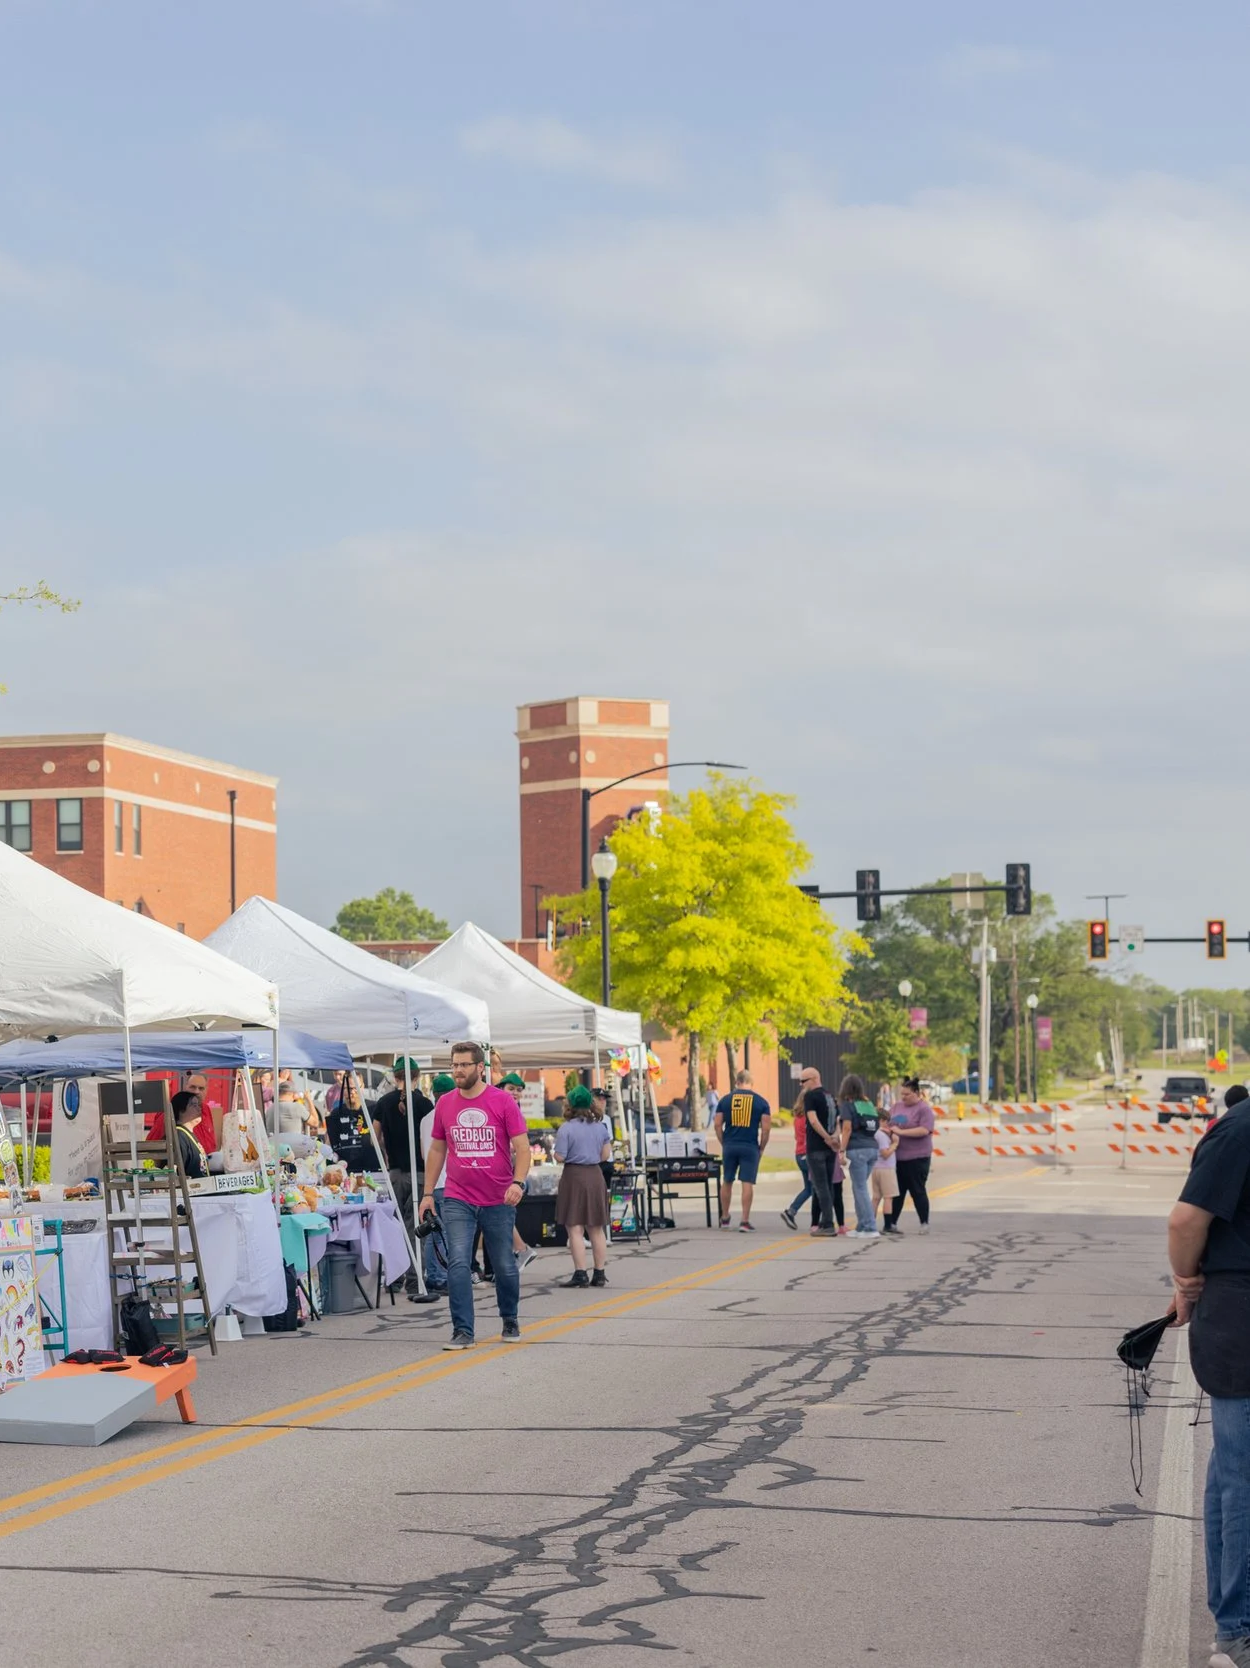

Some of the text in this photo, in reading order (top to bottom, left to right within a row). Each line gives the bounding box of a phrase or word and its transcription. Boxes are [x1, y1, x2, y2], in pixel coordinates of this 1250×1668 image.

[453, 1129, 493, 1142] REDBUD
[457, 1142, 493, 1150] FESTIVAL DAYS
[218, 1175, 254, 1189] BEVERAGES
